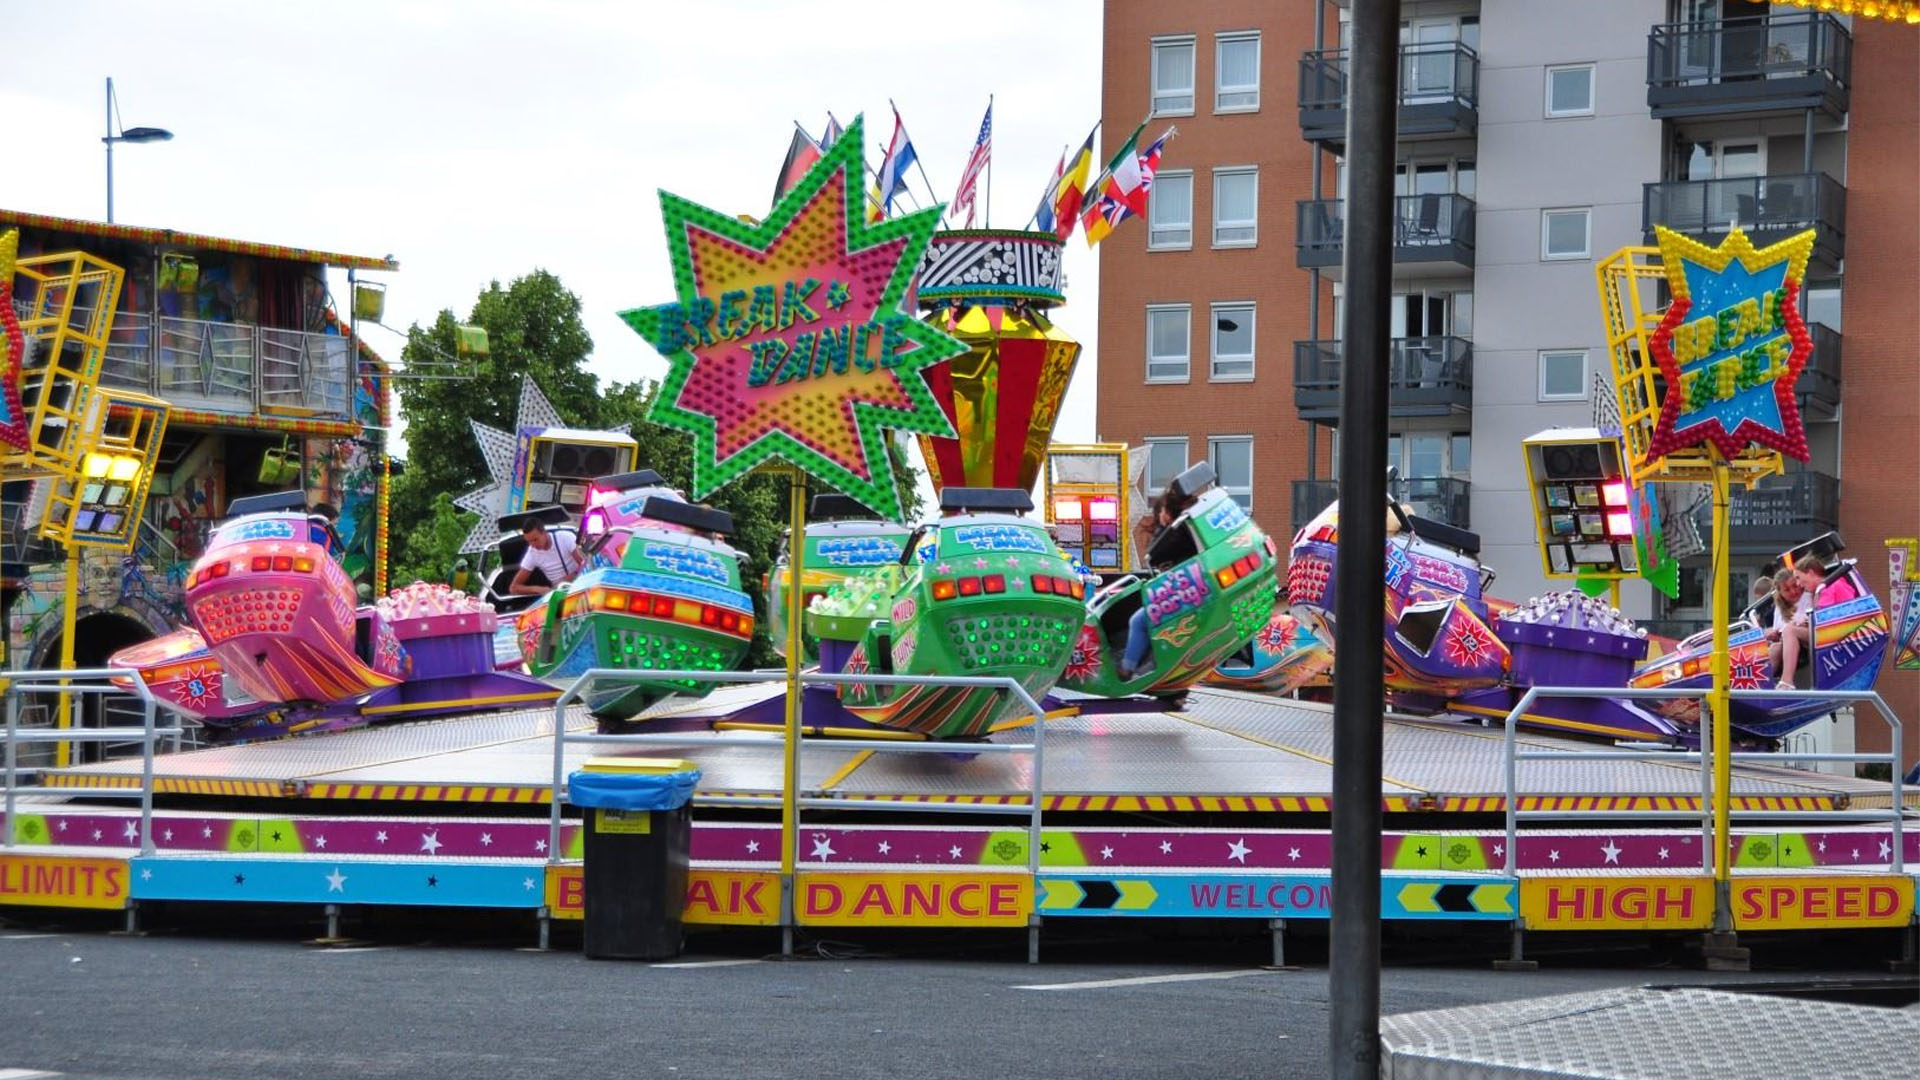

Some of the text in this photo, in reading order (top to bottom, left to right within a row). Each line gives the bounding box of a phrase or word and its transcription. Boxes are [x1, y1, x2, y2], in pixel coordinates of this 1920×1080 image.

[657, 278, 821, 355] BREAK
[741, 316, 908, 387] DANCE
[1822, 617, 1885, 677] ACTION
[188, 679, 206, 697] 3
[0, 864, 121, 898] LIMITS
[557, 876, 1022, 918] BAK DANCE
[1546, 886, 1901, 921] HIGH SPEED
